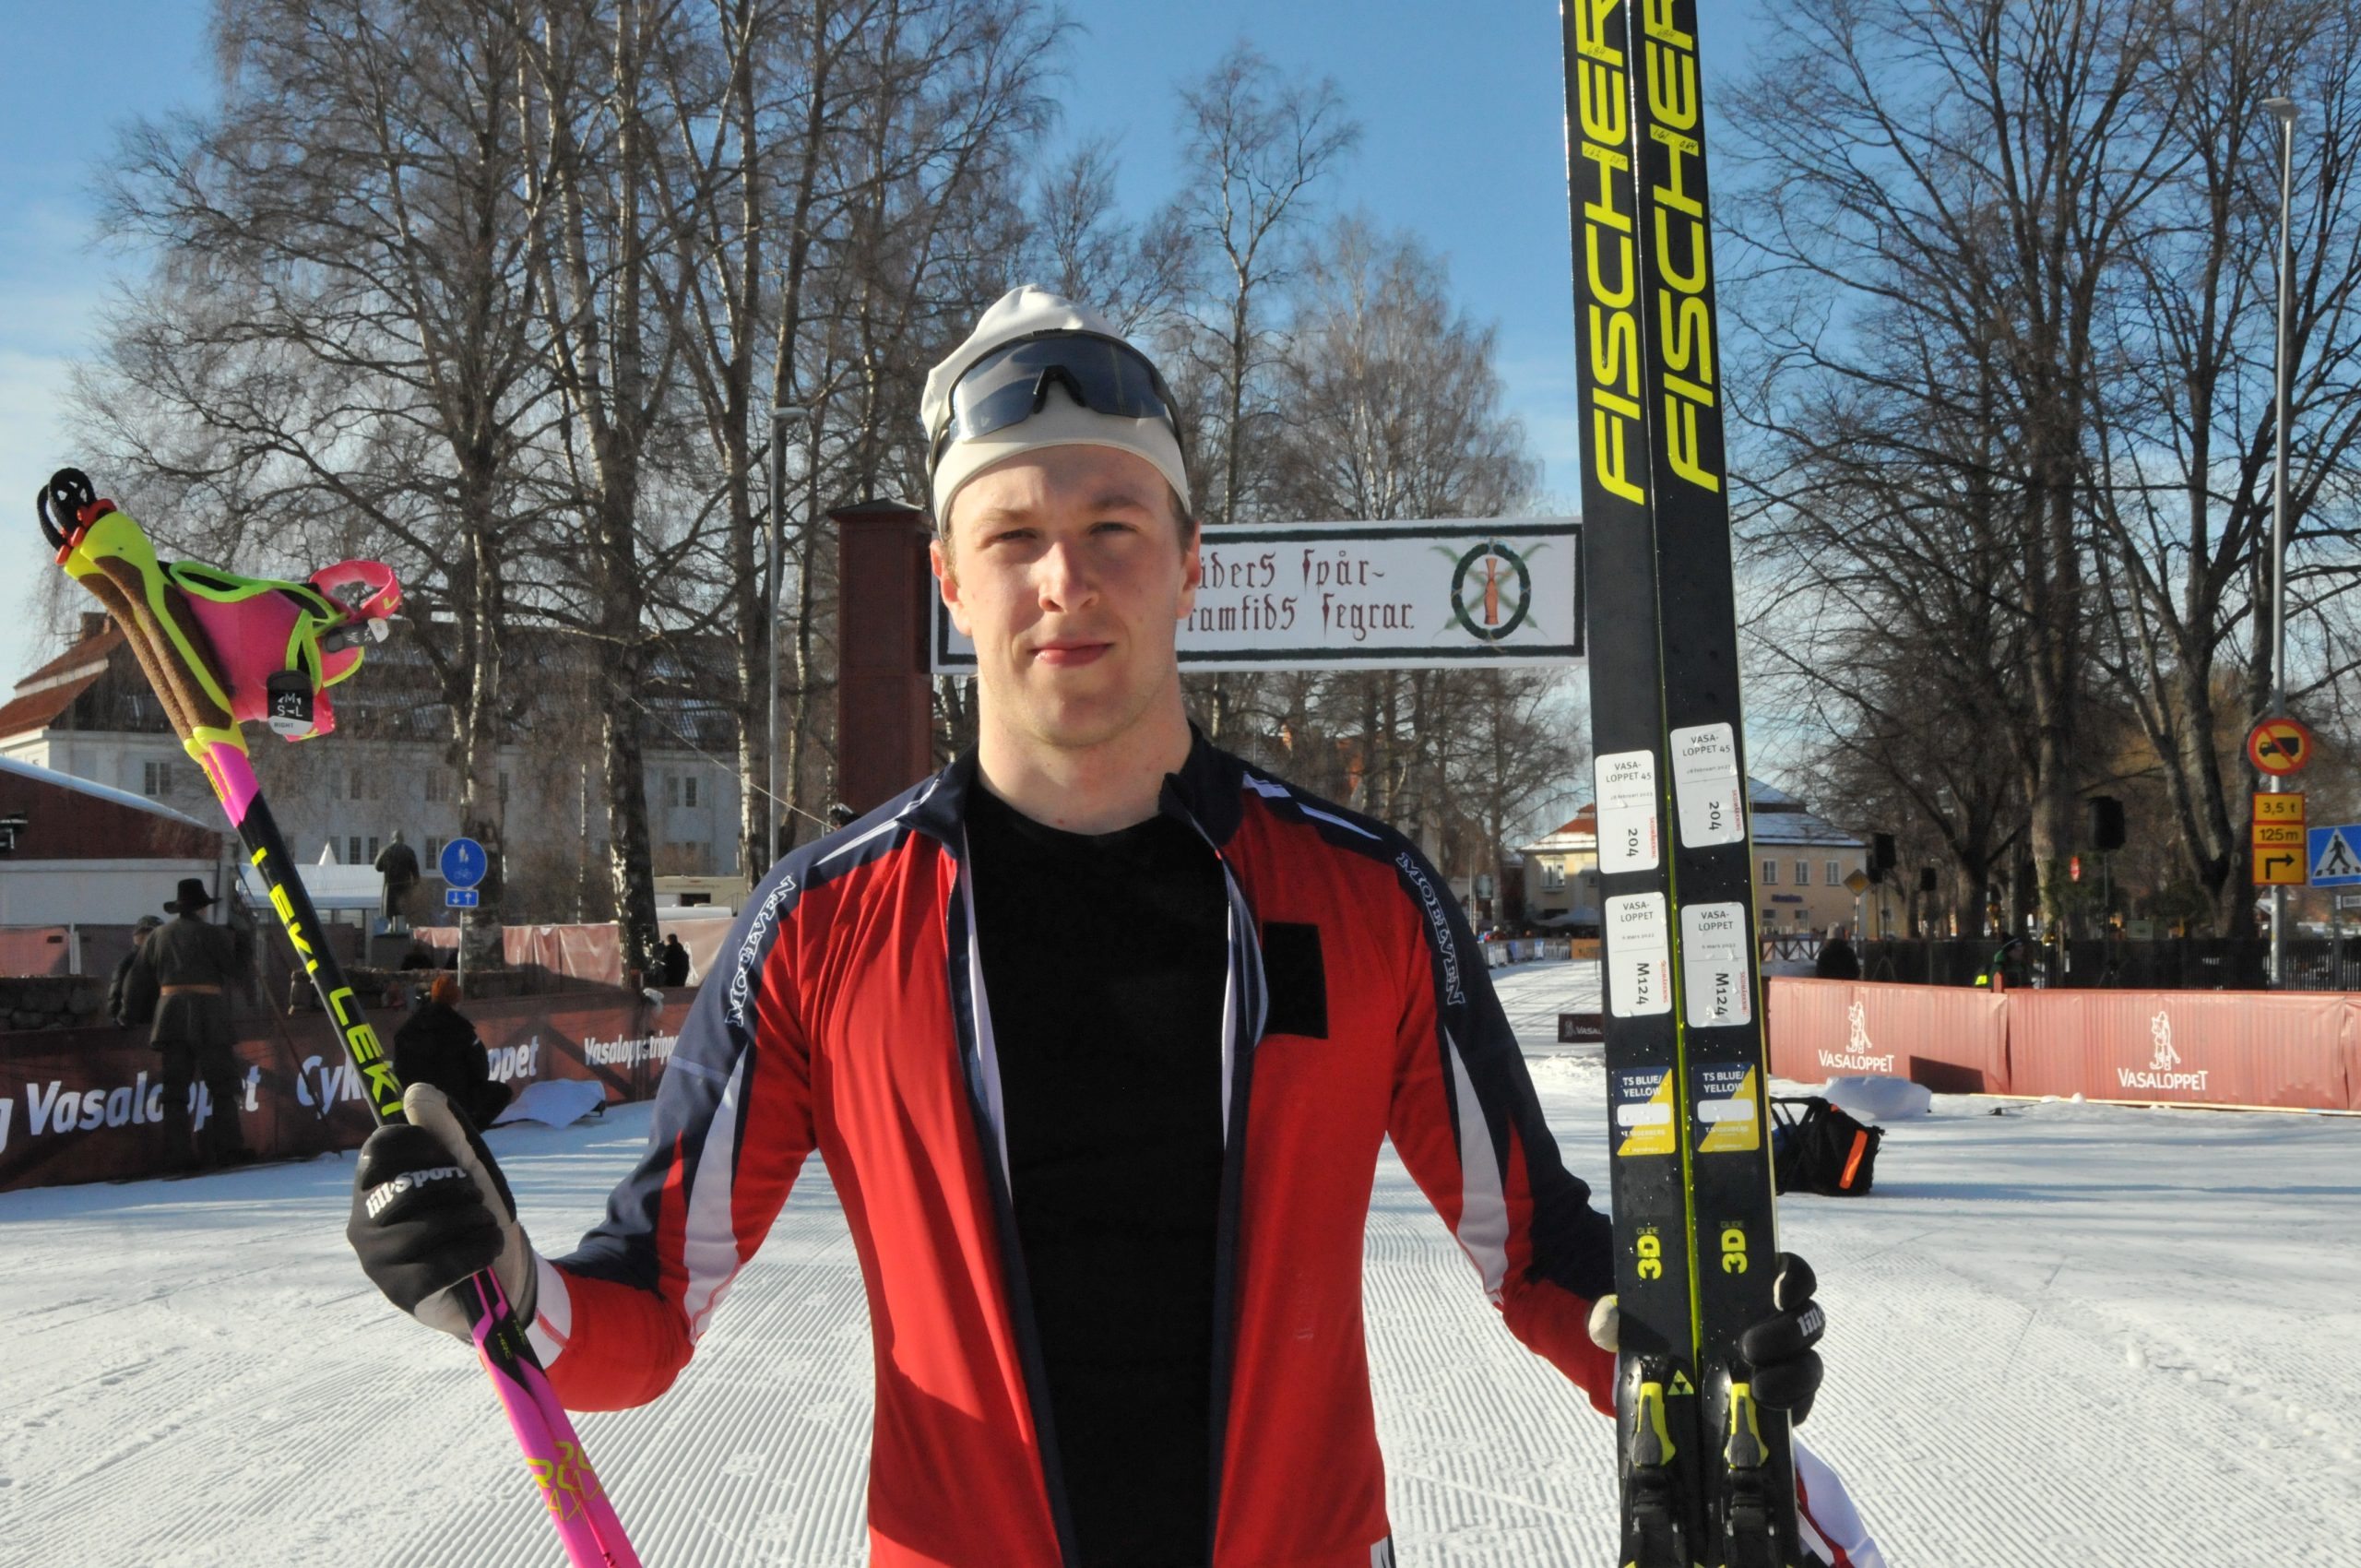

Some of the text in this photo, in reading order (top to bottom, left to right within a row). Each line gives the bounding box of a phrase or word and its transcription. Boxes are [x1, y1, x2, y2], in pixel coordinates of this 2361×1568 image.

[1691, 733, 1719, 744] VASA-
[1682, 744, 1731, 756] LOPPET 45
[1614, 761, 1642, 771] VASA-
[1606, 772, 1652, 783] LOPPET 45
[2263, 802, 2296, 815] 3,5 t
[1708, 801, 1722, 831] 204
[1626, 828, 1639, 858] 204
[1622, 901, 1650, 910] VASA-
[1620, 911, 1654, 922] LOPPET
[1701, 910, 1730, 920] VASA-
[1395, 851, 1466, 1005] MOELVEN
[1698, 921, 1734, 932] LOPPET
[724, 874, 797, 1028] MOELVEN
[1636, 962, 1650, 1005] M124
[1715, 973, 1729, 1016] M124
[329, 987, 403, 1118] LEKI
[1818, 1049, 1895, 1073] VASALOPPET
[1622, 1076, 1634, 1086] TS
[1702, 1071, 1745, 1081] TS BLUE/
[2117, 1067, 2209, 1090] VASALOPPET
[1623, 1087, 1662, 1098] YELLOW
[1703, 1083, 1745, 1093] YELLOW
[1637, 1235, 1662, 1279] 3D
[1721, 1229, 1748, 1274] 3D
